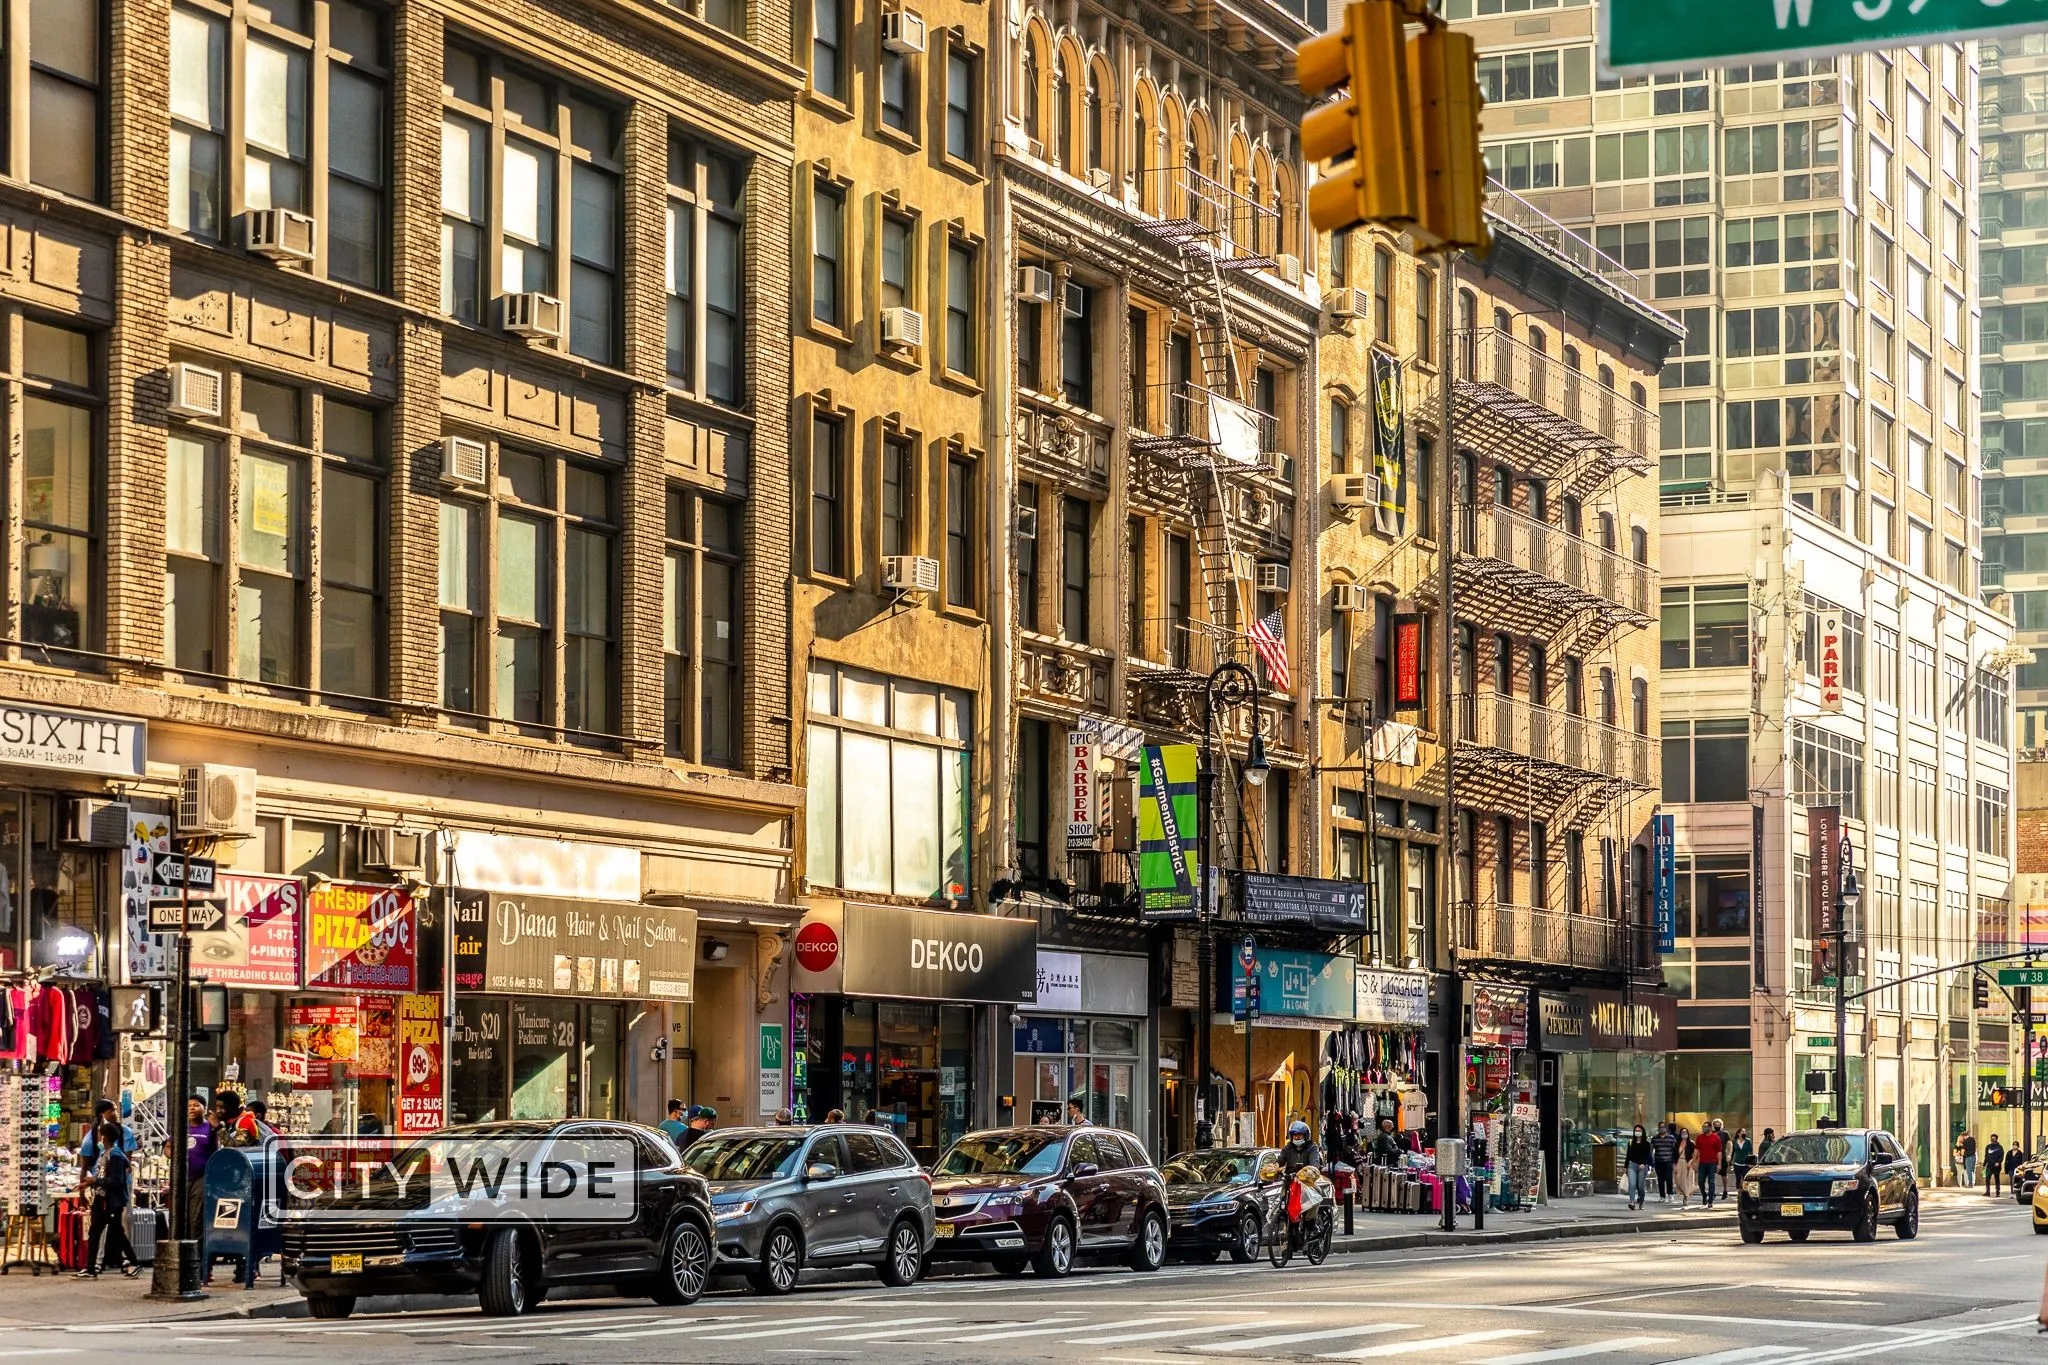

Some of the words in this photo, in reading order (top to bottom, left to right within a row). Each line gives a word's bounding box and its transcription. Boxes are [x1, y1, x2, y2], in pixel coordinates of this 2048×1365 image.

[1823, 635, 1839, 687] PARK
[1, 709, 120, 755] SIXTH
[1069, 733, 1093, 745] EPIC
[45, 752, 84, 764] 11:45PM
[1073, 746, 1088, 822] BARBER
[1150, 757, 1185, 875] #GarmentDistrict
[1068, 824, 1093, 835] SHOP
[162, 863, 180, 878] ONE
[189, 867, 208, 881] WAY
[1277, 890, 1292, 898] SEOUL
[1821, 877, 1829, 896] YOU
[188, 879, 297, 915] NKY'S
[314, 888, 367, 912] FRESH
[1274, 902, 1300, 910] BOOKSTORE
[1350, 893, 1365, 919] 2F
[159, 909, 181, 922] ONE
[191, 909, 215, 922] WAY
[497, 900, 557, 946] Diana
[566, 911, 595, 937] Hair
[599, 914, 609, 941] &
[613, 915, 641, 945] Nail
[644, 917, 676, 947] Salon
[313, 913, 371, 949] PIZZA
[251, 944, 297, 959] 4-PINKYS
[796, 942, 838, 953] DEKCO
[911, 939, 983, 973] DEKCO
[190, 967, 213, 978] HAPE
[216, 968, 266, 980] THREADING
[269, 970, 297, 981] SALON
[2020, 973, 2027, 982] W
[2032, 972, 2043, 982] 38
[509, 977, 513, 987] 6
[515, 977, 526, 988] Ave
[528, 978, 537, 988] 39
[537, 978, 544, 989] St
[1371, 974, 1378, 993] &
[1381, 975, 1423, 997] LUGGAGE
[1021, 990, 1033, 998] 1030
[402, 994, 440, 1019] FRESH
[1294, 1001, 1310, 1010] GAME
[480, 1012, 500, 1041] $20
[518, 1013, 550, 1029] Manicure
[672, 1022, 681, 1032] ve
[1548, 1016, 1583, 1035] JEWELRY
[1599, 1002, 1615, 1036] PRET
[1617, 1003, 1622, 1035] A
[1623, 1004, 1653, 1037] MNGER
[402, 1020, 440, 1044] PIZZA
[464, 1027, 479, 1046] Dry
[518, 1030, 548, 1045] Pedicure
[1486, 1057, 1507, 1065] OUT
[402, 1097, 415, 1110] GET
[417, 1097, 422, 1110] 2
[423, 1096, 442, 1111] SLICE
[1514, 1106, 1528, 1115] .99
[403, 1112, 440, 1128] PIZZA
[312, 1148, 343, 1160] SLICE
[359, 1141, 381, 1151] SLICE
